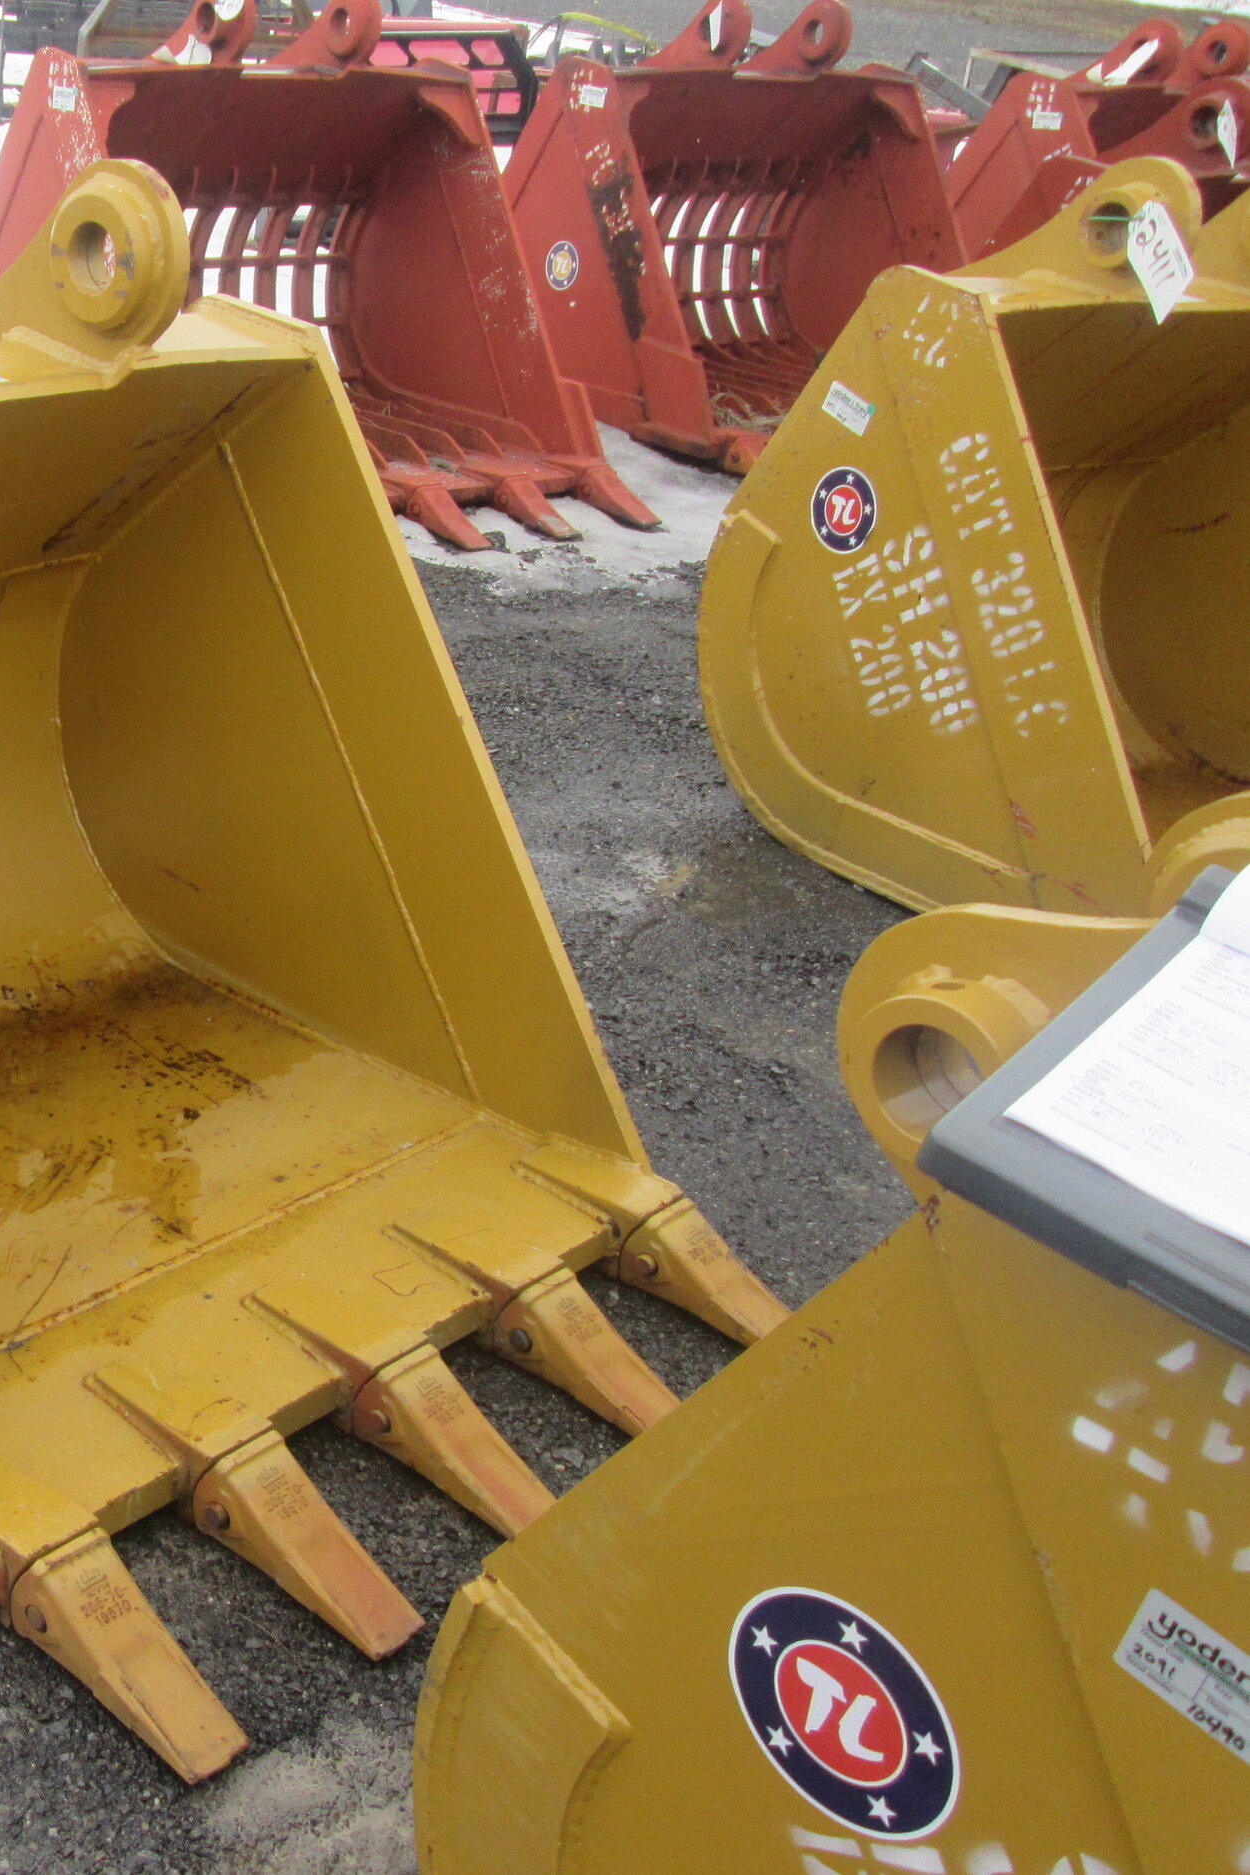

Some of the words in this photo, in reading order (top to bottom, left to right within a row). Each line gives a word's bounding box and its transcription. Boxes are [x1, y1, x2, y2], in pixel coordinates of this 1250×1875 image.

[938, 432, 1015, 540] CAT
[833, 553, 888, 619] EX
[971, 551, 1046, 658] 320
[851, 624, 912, 717] 200
[910, 630, 980, 735] 200
[1147, 1611, 1250, 1683] yoder
